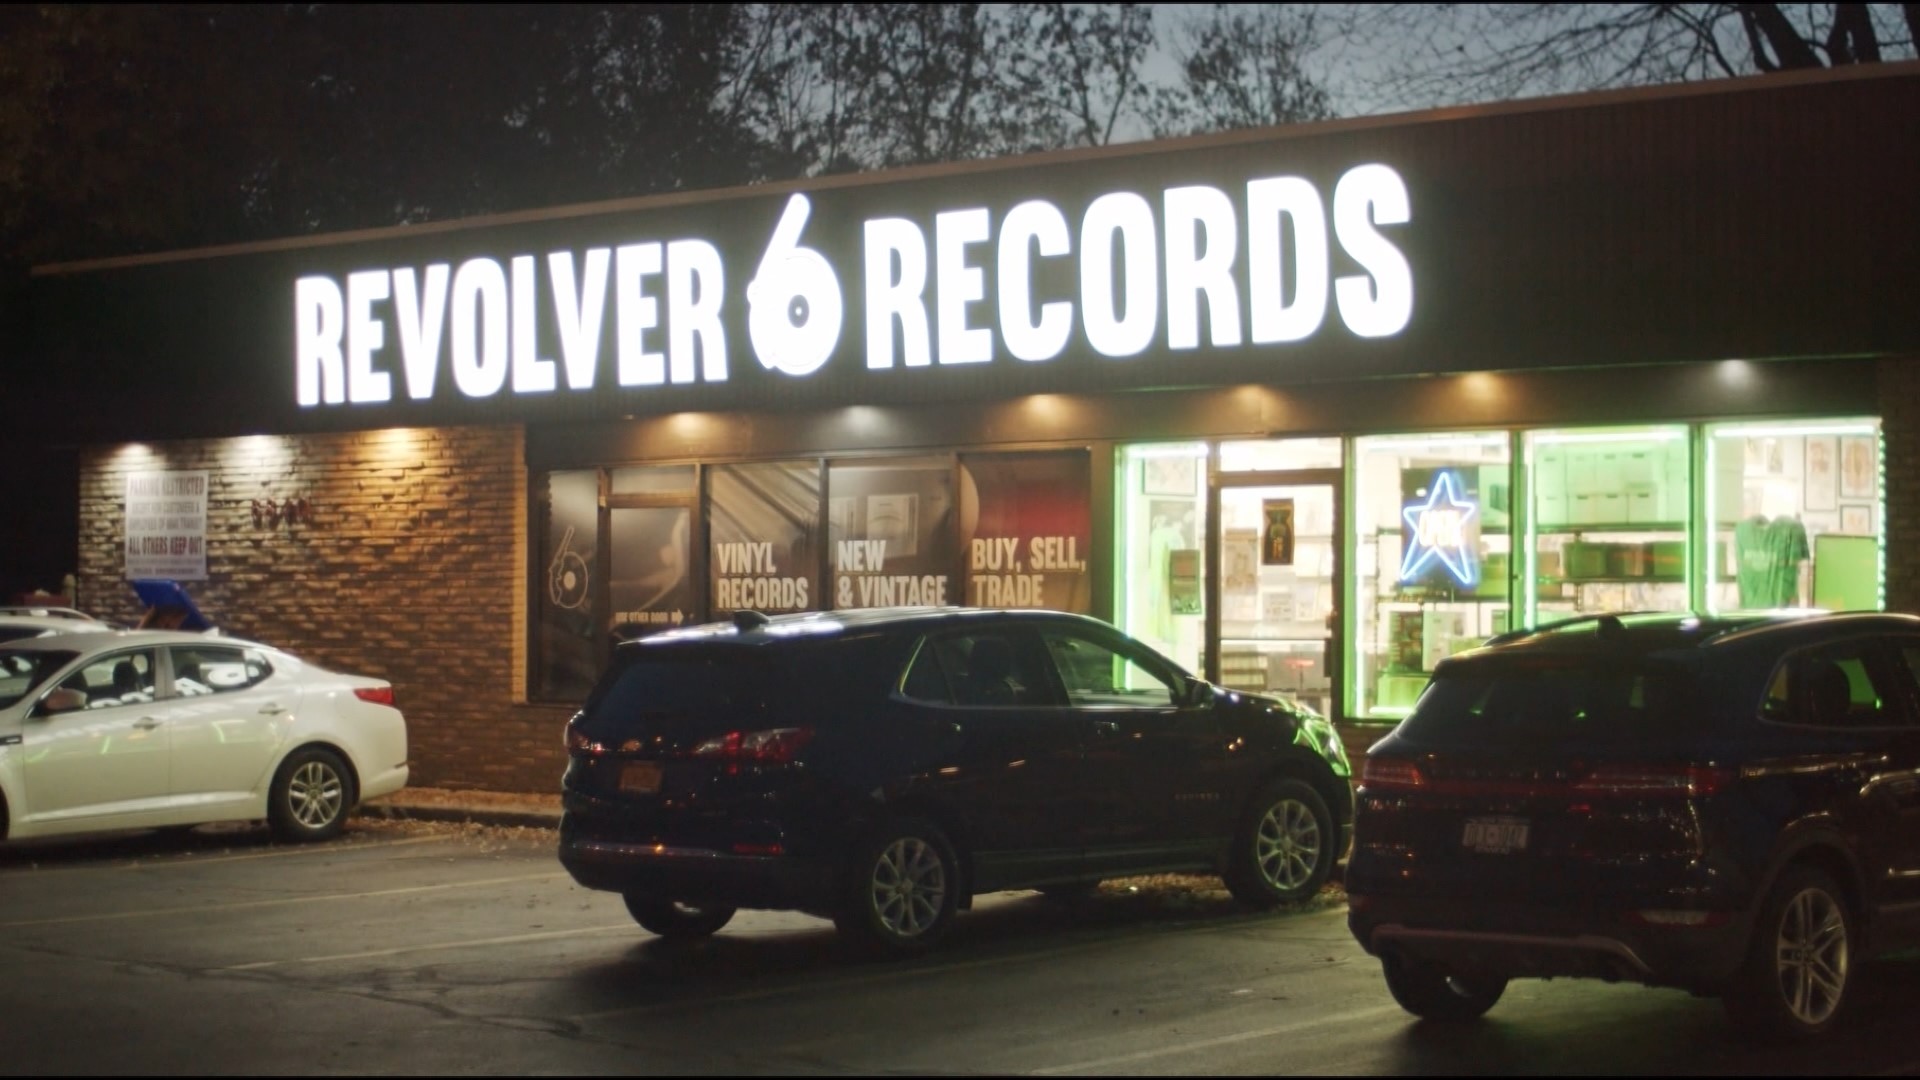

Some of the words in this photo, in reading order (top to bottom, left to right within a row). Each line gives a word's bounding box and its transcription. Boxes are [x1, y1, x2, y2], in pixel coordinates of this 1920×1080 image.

[296, 240, 727, 405] REVOLVER
[863, 163, 1413, 370] RECORDS
[162, 476, 204, 496] RESTRICTED
[129, 536, 140, 554] ALL
[142, 536, 167, 554] OTHERS
[170, 536, 187, 554] KEEP
[189, 536, 202, 554] OUT
[717, 542, 776, 574] VINYL
[837, 540, 887, 572] NEW
[971, 537, 1021, 573] BUY,
[1030, 536, 1087, 573] SELL,
[718, 577, 808, 609] RECORDS
[837, 575, 854, 608] &
[858, 575, 947, 607] VINTAGE
[972, 575, 1044, 607] TRADE
